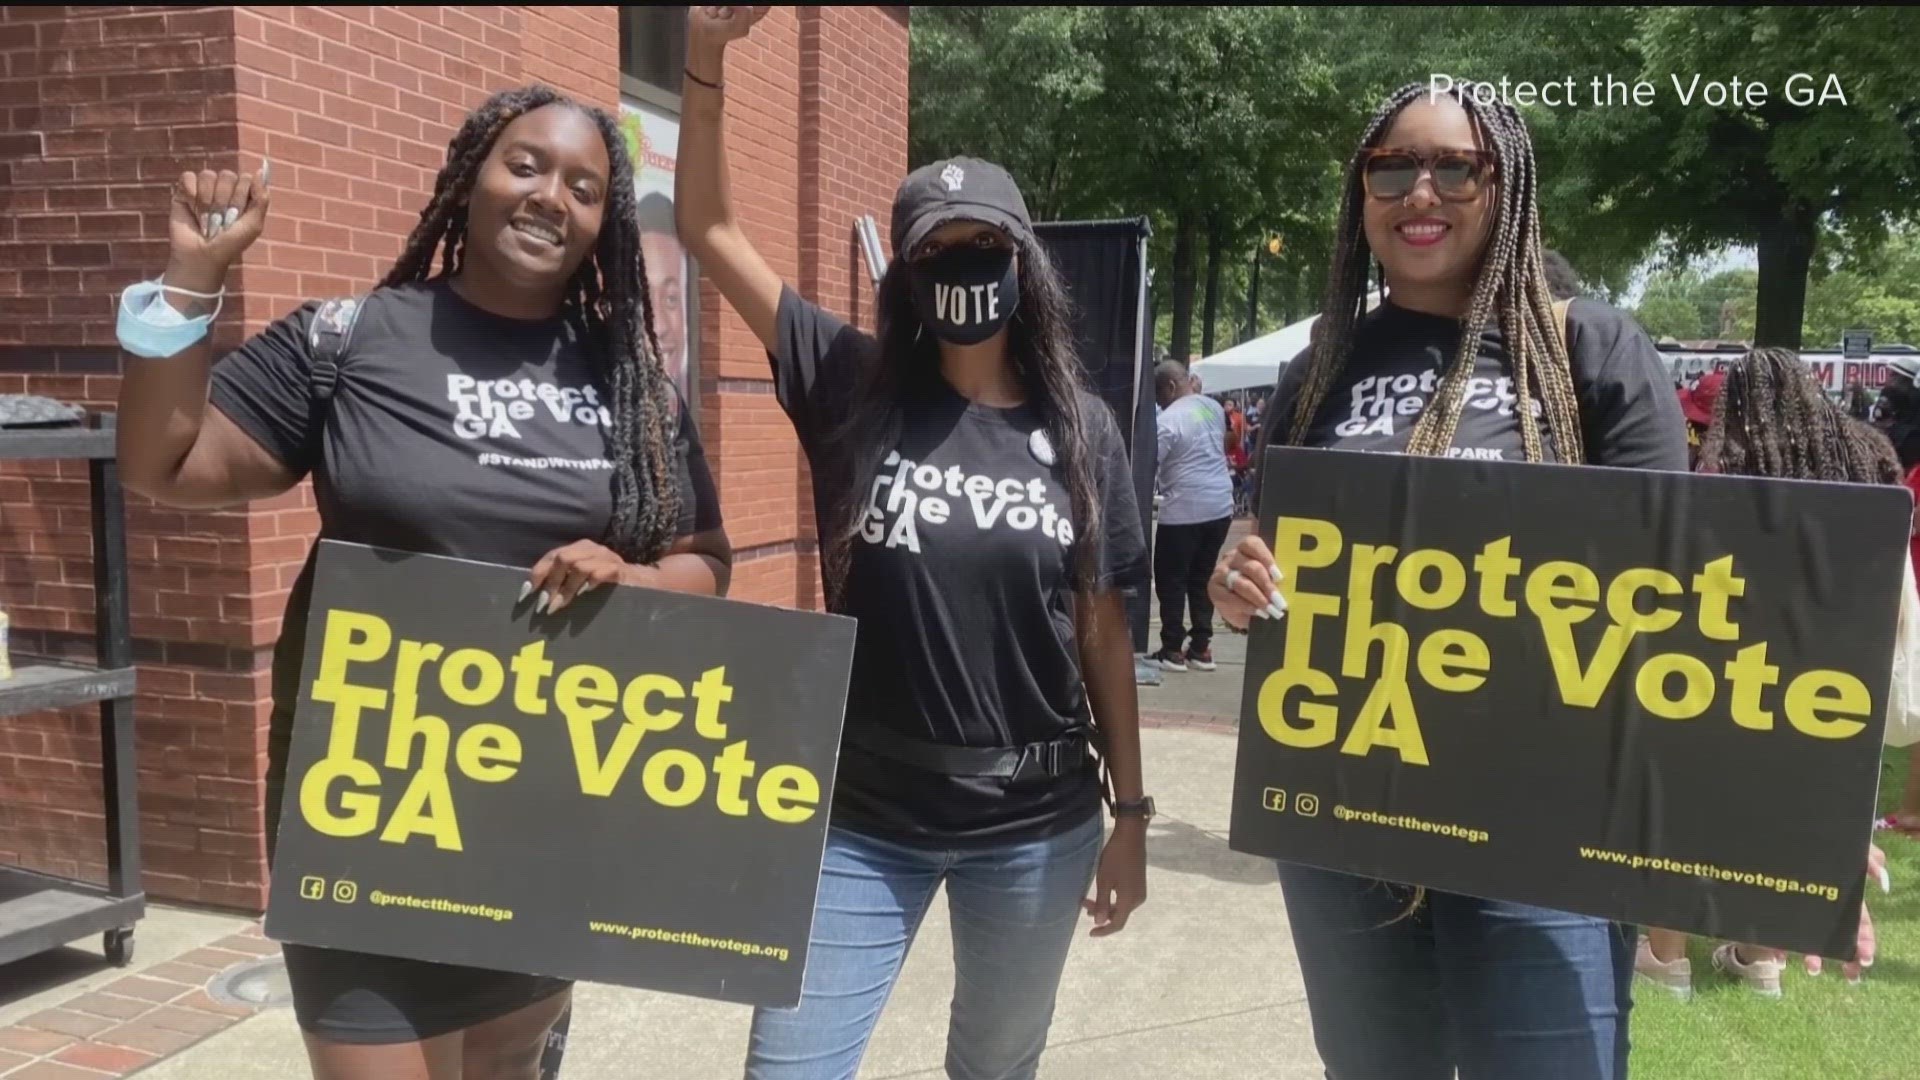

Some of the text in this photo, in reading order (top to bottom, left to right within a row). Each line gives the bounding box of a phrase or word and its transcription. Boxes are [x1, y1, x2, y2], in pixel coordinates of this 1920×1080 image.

[935, 281, 999, 326] VOTE
[447, 373, 600, 406] Protect
[448, 394, 613, 427] The Vot
[1351, 368, 1517, 402] Protct
[453, 411, 522, 440] GA
[1335, 414, 1395, 438] GA
[478, 452, 615, 470] #STANDWITHPA
[860, 505, 922, 555] GA
[969, 494, 1075, 547] Vote
[1274, 515, 1746, 642] Protect
[318, 608, 734, 740] Protect
[1276, 590, 1873, 740] The Vote
[1256, 665, 1430, 767] GA
[310, 678, 821, 824] The Vote
[299, 757, 464, 852] GA
[1333, 803, 1840, 902] @protectthevotega www.protectthevotega.org
[369, 888, 790, 961] @protectthevotega www.protectthevotega.org
